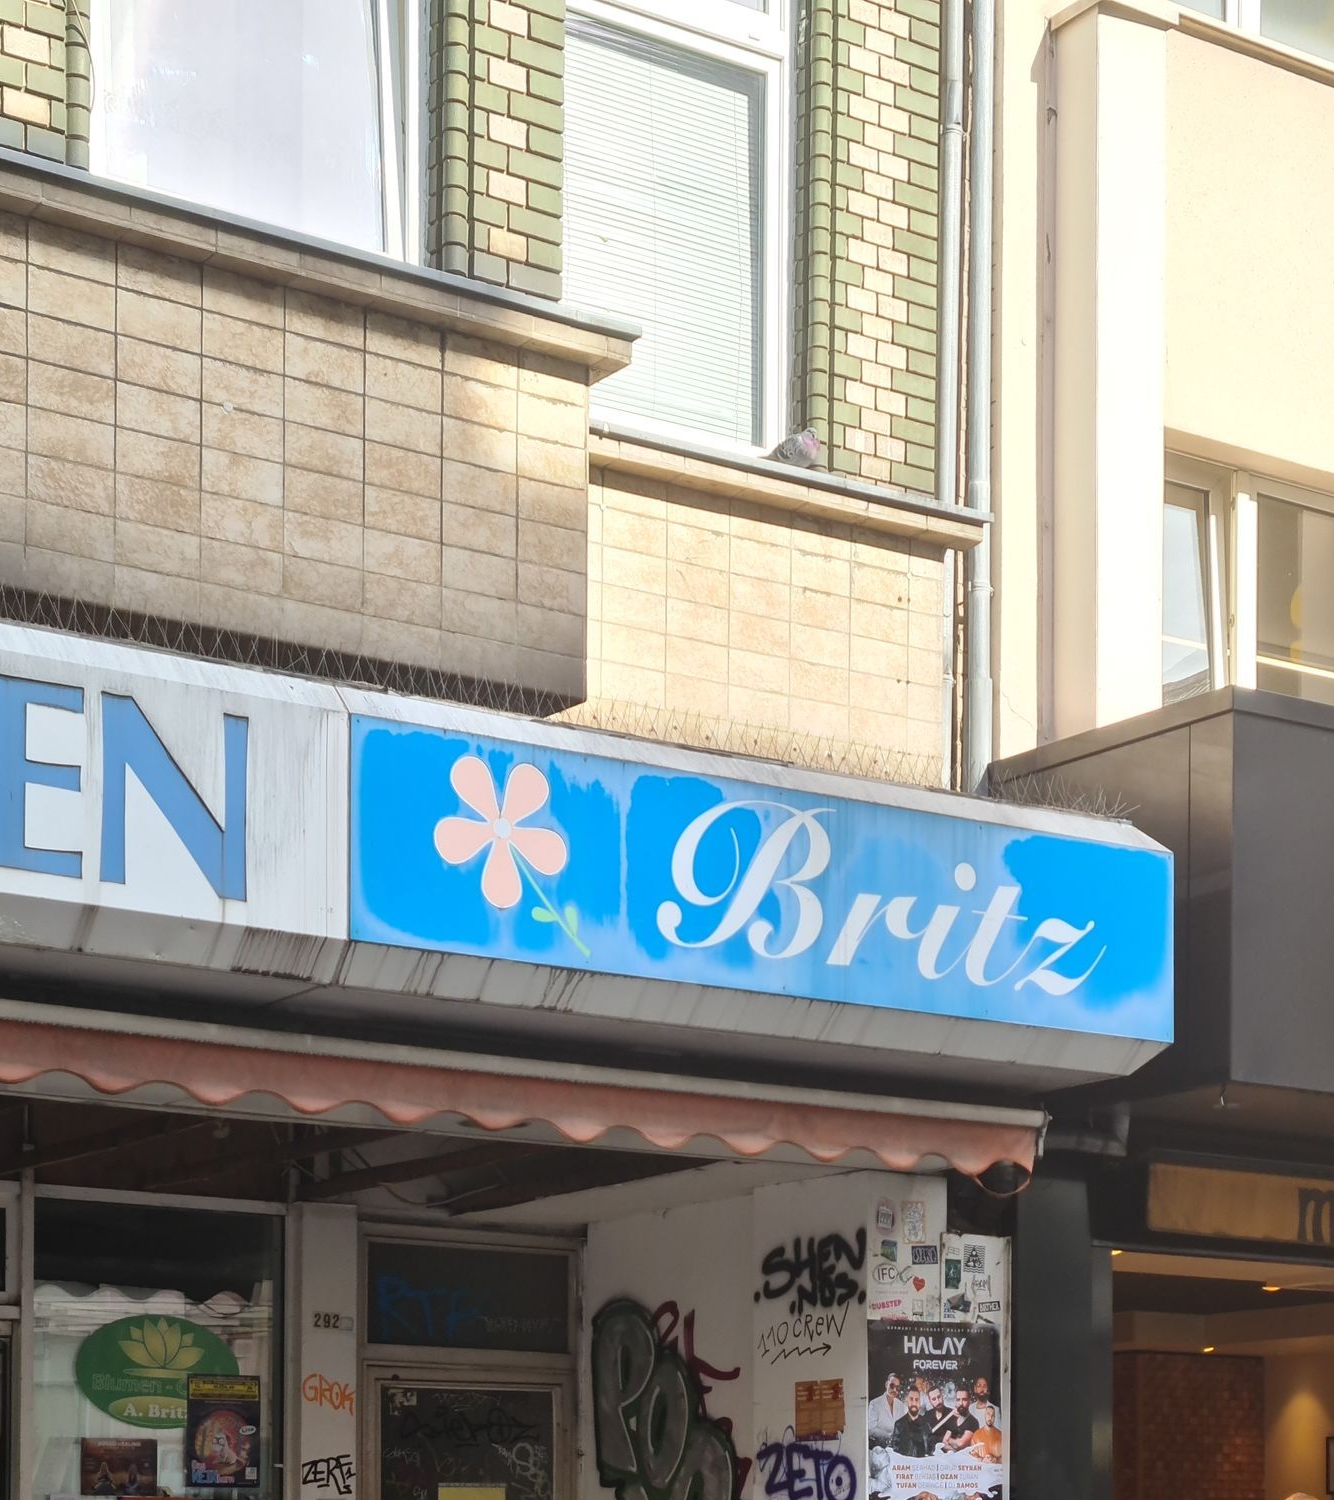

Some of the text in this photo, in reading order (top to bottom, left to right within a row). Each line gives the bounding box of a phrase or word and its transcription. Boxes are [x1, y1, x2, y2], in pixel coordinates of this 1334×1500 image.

[657, 798, 1114, 1002] Britz
[314, 1313, 341, 1328] 292
[903, 1335, 967, 1356] HALAY
[913, 1359, 959, 1370] FOREVER
[123, 1403, 143, 1417] A.
